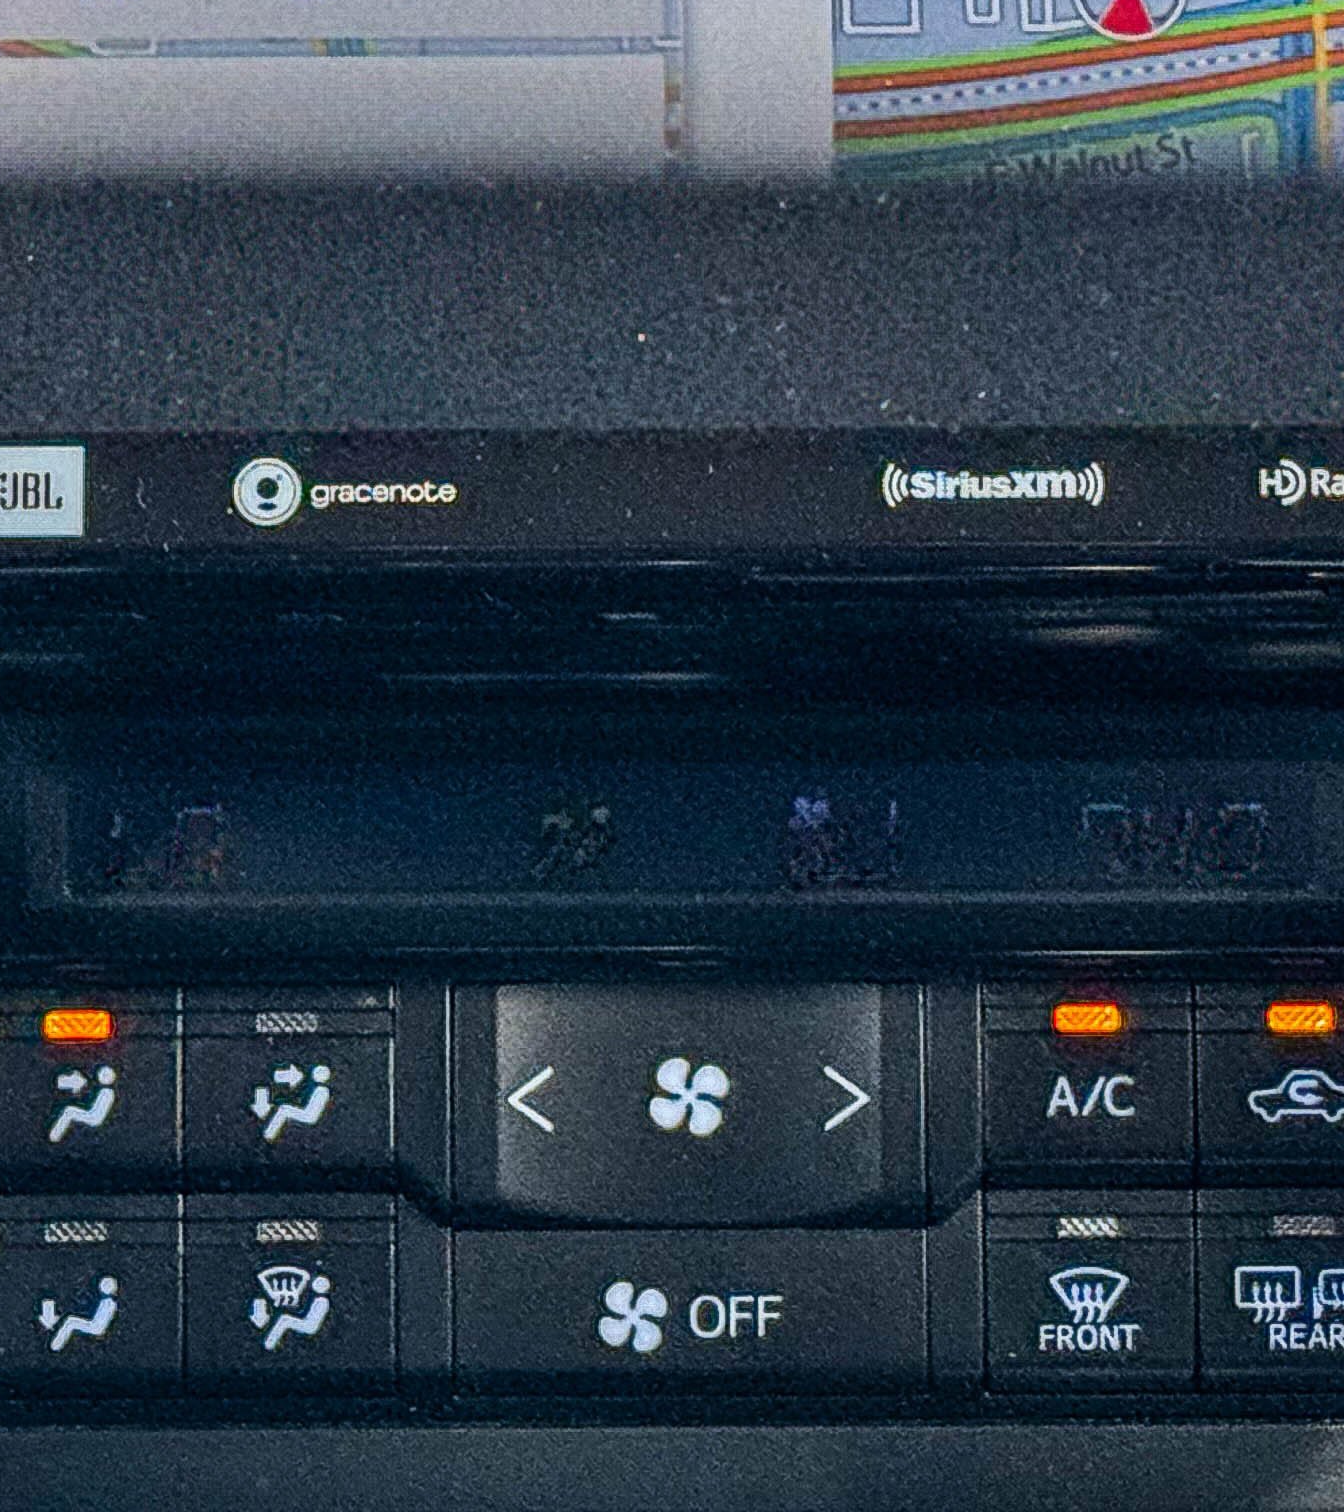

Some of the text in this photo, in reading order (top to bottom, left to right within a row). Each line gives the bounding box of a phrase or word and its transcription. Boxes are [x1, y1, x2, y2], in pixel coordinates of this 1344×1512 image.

[0, 471, 64, 510] JBL
[310, 479, 457, 510] gracenote
[1047, 1074, 1136, 1118] A/C
[688, 1294, 783, 1340] OFF
[1038, 1323, 1142, 1352] FRONT
